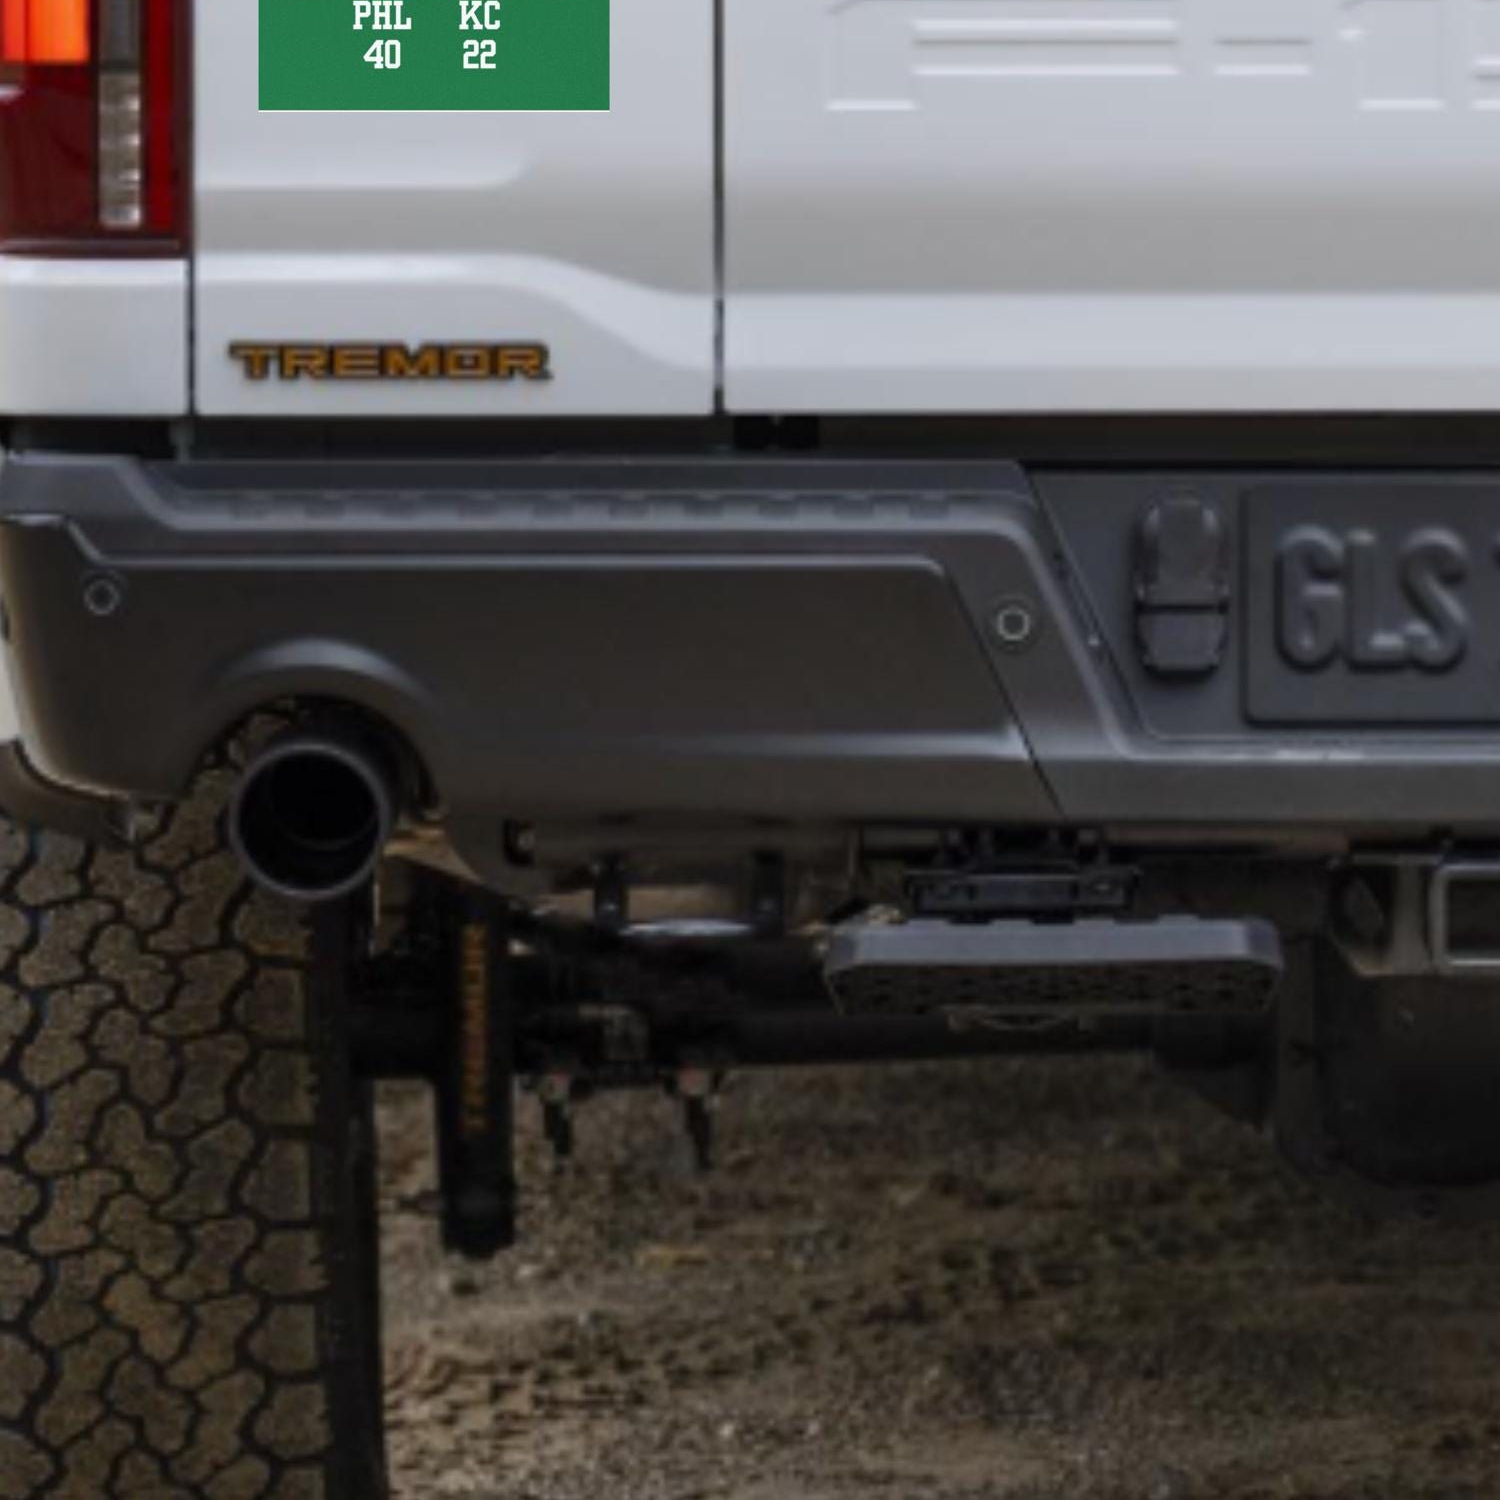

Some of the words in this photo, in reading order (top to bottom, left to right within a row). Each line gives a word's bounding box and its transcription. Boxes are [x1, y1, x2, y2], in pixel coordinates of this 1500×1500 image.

[352, 0, 412, 30] PHL
[458, 0, 501, 30] KC
[362, 39, 401, 69] 40
[462, 39, 497, 69] 22
[228, 340, 554, 380] TREMOR
